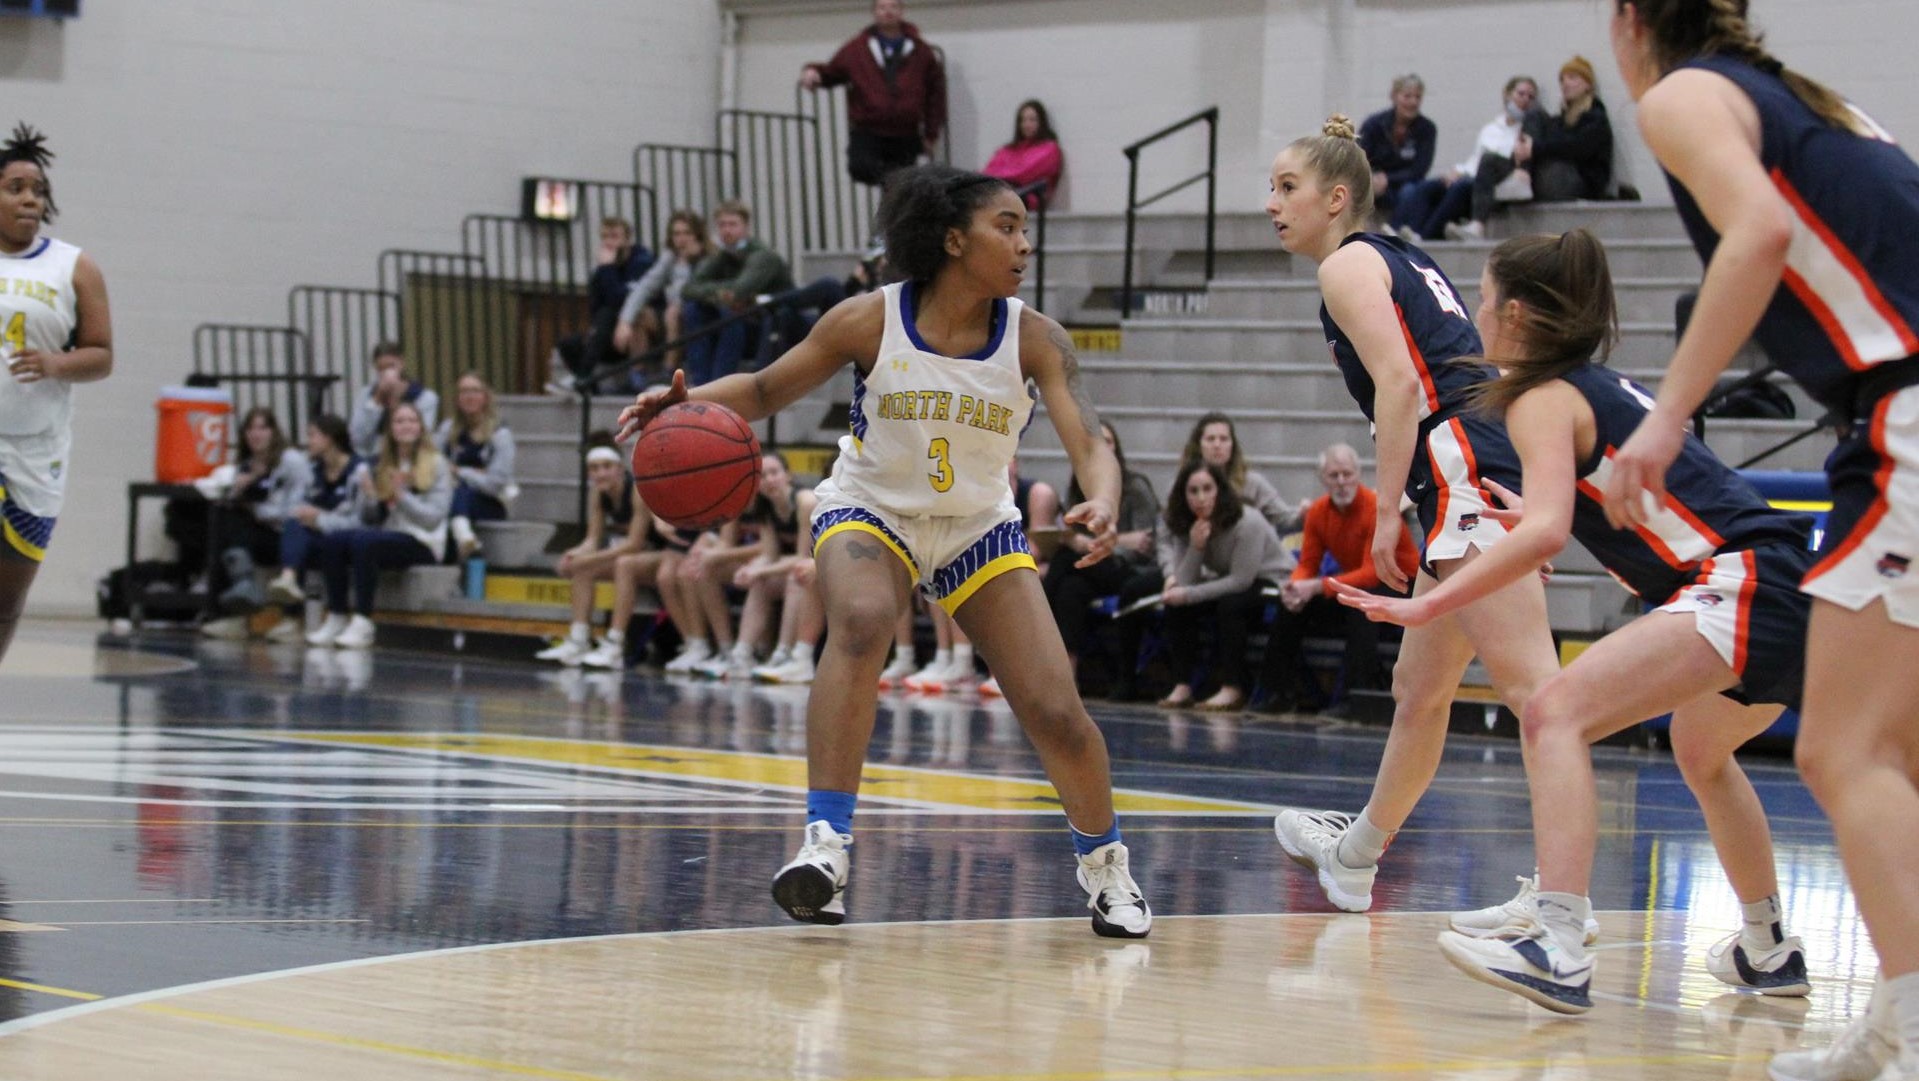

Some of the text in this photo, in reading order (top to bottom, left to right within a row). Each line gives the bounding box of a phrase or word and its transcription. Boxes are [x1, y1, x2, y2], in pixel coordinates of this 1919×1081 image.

[878, 390, 1014, 436] NORTH PARK
[928, 437, 955, 493] 3
